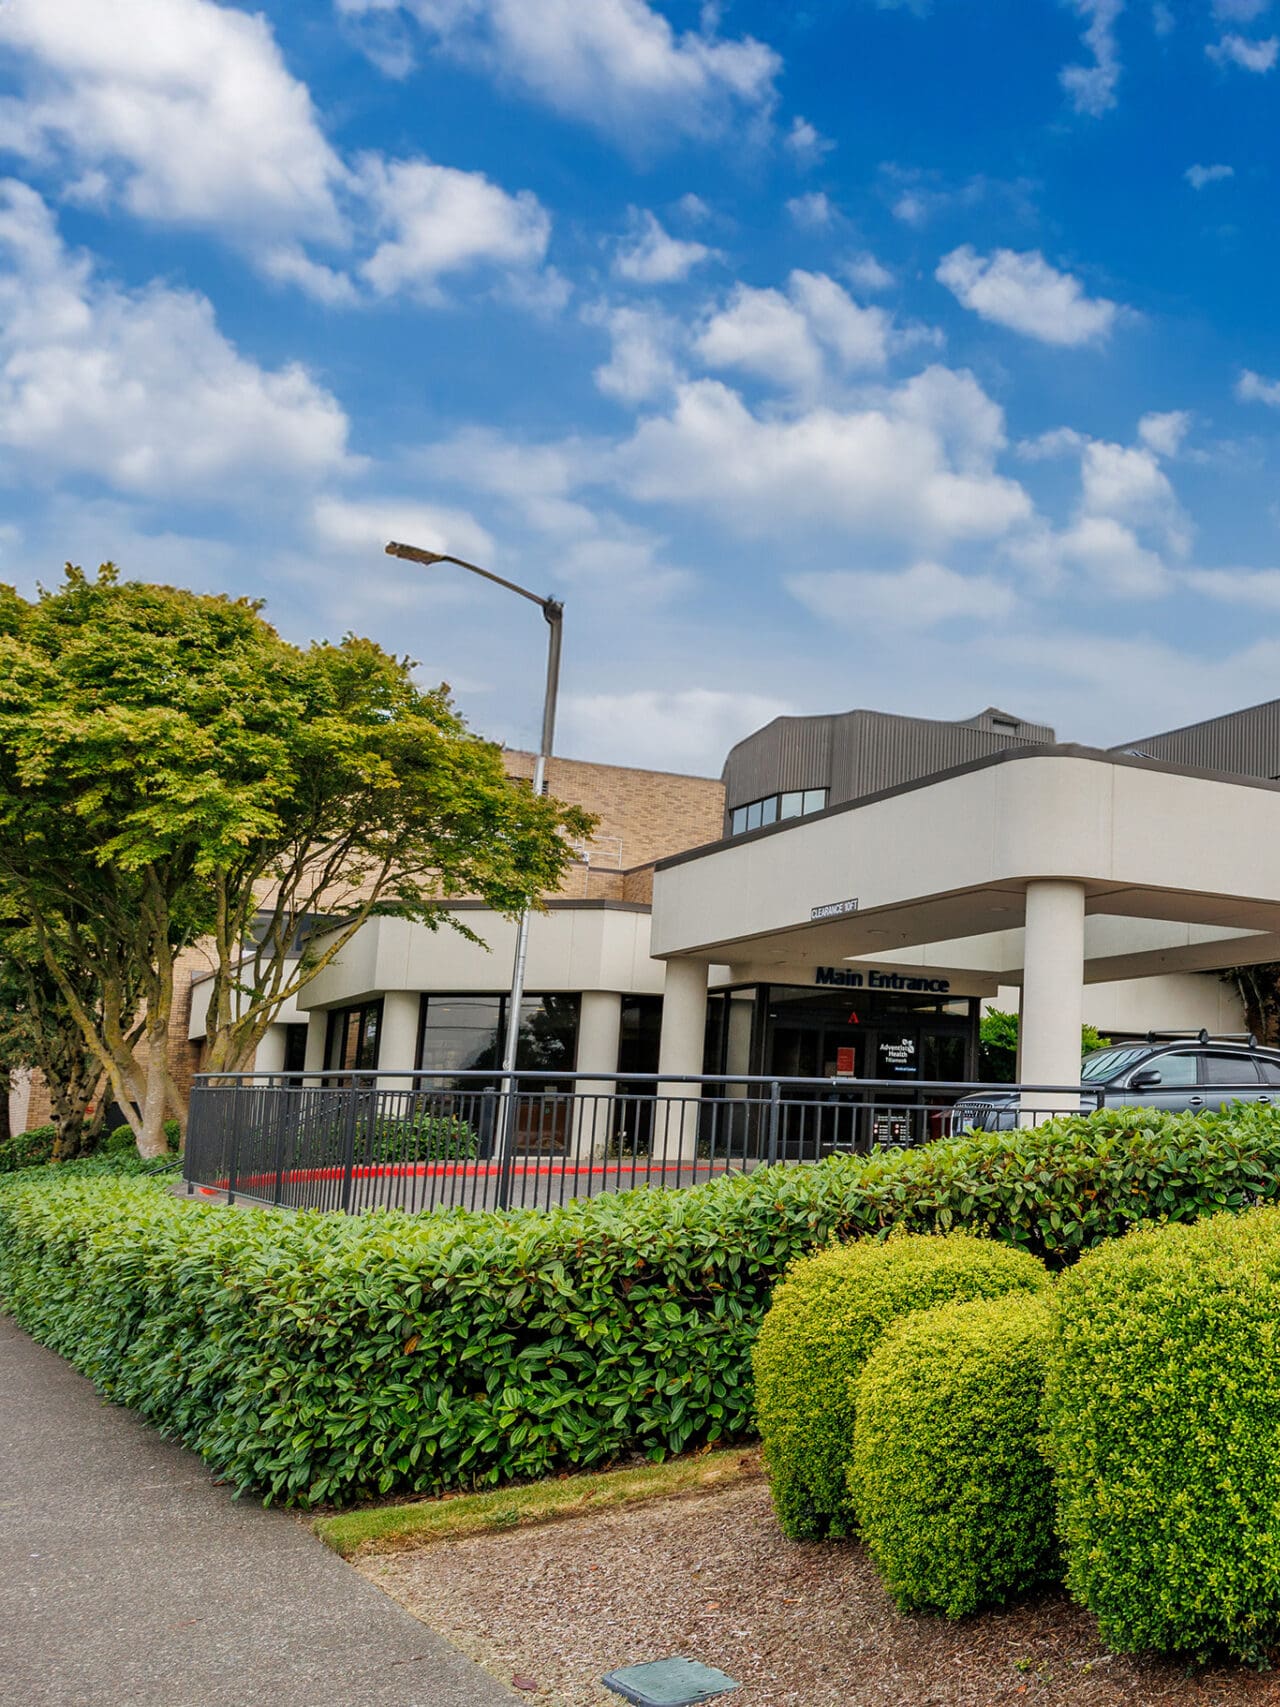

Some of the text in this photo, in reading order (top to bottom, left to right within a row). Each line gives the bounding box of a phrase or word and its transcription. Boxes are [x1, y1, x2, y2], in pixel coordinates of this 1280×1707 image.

[811, 903, 844, 919] CLEARANCE
[815, 966, 950, 993] Main Entrance
